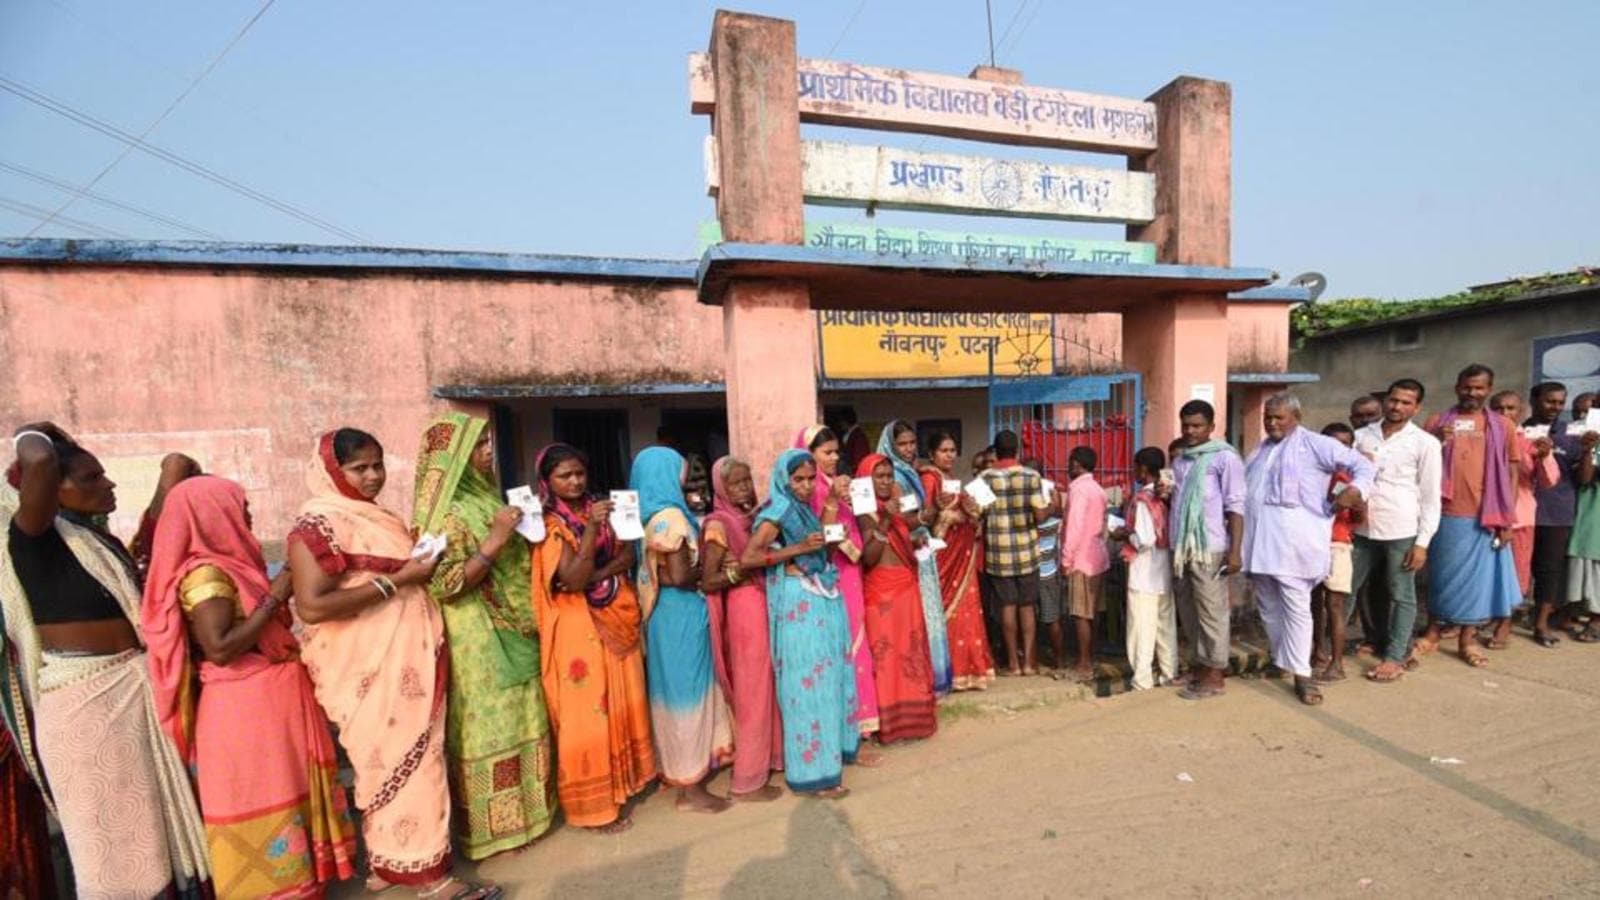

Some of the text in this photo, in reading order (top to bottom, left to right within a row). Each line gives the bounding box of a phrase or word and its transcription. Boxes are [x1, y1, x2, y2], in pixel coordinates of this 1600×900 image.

[799, 65, 897, 105] प्राथमिक
[902, 80, 989, 117] विद्यालय
[959, 335, 1001, 355] पटना
